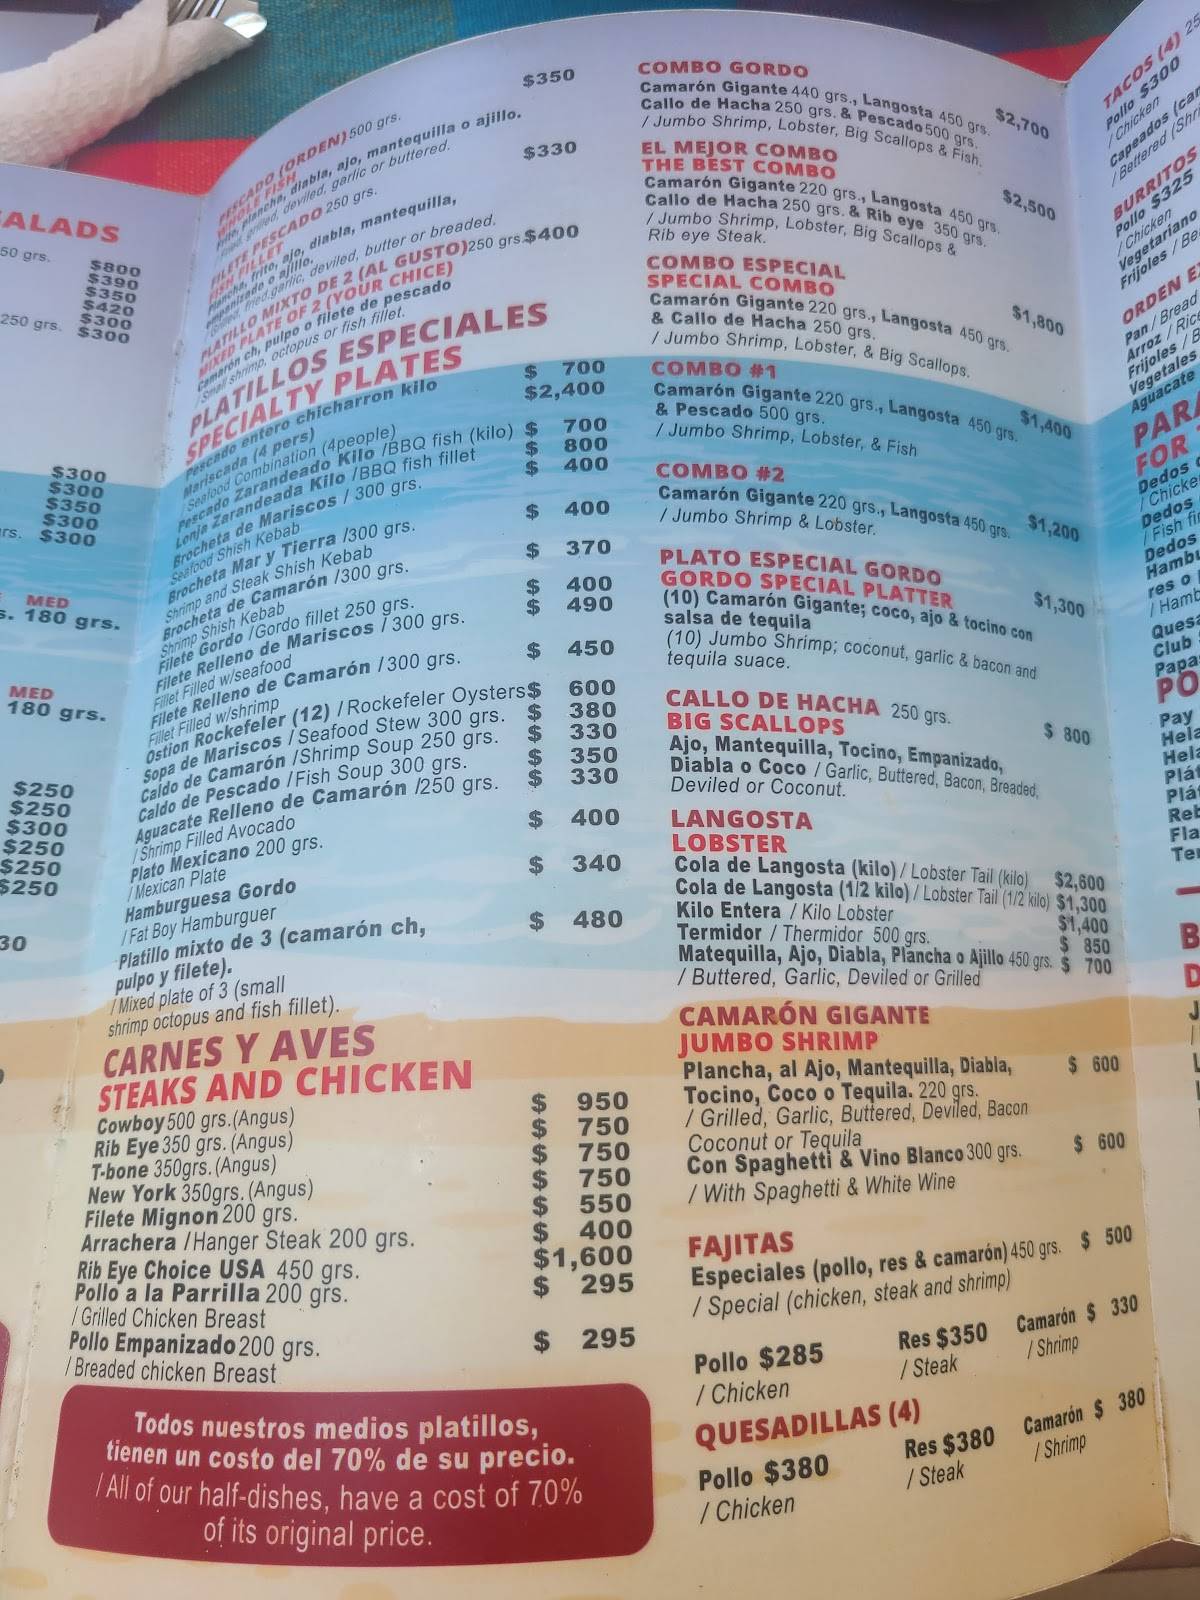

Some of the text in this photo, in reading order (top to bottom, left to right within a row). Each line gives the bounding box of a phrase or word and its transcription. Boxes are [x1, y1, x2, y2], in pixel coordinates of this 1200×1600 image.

[523, 69, 575, 88] $350
[638, 60, 809, 78] COMBO GORDO
[1103, 31, 1181, 109] TACOS (4)
[640, 78, 991, 137] Camarón Gigante 440 grs., Langosta 450 grs.
[1107, 99, 1135, 131] Pollo
[995, 107, 1049, 140] $2,700
[279, 113, 400, 179] (ORDEN) 500 grs.
[291, 110, 521, 195] diabla, ajo, mantequilla o ajillo.
[523, 141, 577, 160] $330
[642, 140, 838, 163] EL MEJOR COMBO
[1113, 146, 1197, 221] BURRITOS
[1002, 188, 1057, 222] $2,500
[253, 207, 323, 255] PESCADO
[326, 195, 348, 214] 250
[353, 188, 377, 205] grs.
[365, 214, 495, 256] butter or breaded.
[524, 225, 579, 244] $400
[1115, 209, 1145, 238] Pollo
[648, 228, 766, 245] Rib eye Steak.
[1119, 210, 1197, 271] Vegetariano
[88, 273, 138, 290] $390
[90, 260, 140, 278] $800
[82, 300, 134, 316] $420
[86, 286, 136, 304] $350
[1122, 275, 1181, 324] ORDEN
[1, 314, 62, 332] 250 grs.
[80, 313, 132, 330] $300
[1011, 304, 1065, 337] $1,800
[1127, 334, 1161, 362] Arroz
[189, 302, 549, 438] PLATILLOS ESPECIALES
[1129, 351, 1197, 395] Vegetales
[185, 345, 463, 466] SPECIALTY PLATES
[296, 380, 437, 424] chicharron kilo
[525, 381, 605, 402] $2,400
[1132, 371, 1195, 414] Aguacate
[1136, 434, 1189, 477] FOR
[52, 466, 106, 483] $300
[178, 498, 229, 534] Pescado
[234, 459, 331, 502] Zarandeado
[338, 448, 375, 467] Kilo
[432, 431, 462, 446] fish
[470, 424, 513, 444] (kilo)
[656, 463, 784, 483] COMBO #2
[1138, 462, 1189, 494] Dedos
[48, 481, 104, 498] $300
[45, 498, 101, 514] $350
[1028, 514, 1080, 543] $1,200
[660, 549, 941, 587] PLATO ESPECIAL GORDO
[26, 595, 69, 609] MED
[1034, 590, 1086, 619] $1,300
[24, 609, 120, 630] 180 grs.
[158, 651, 194, 674] Filete
[199, 631, 243, 657] Gordo
[306, 607, 339, 626] fillet
[345, 600, 375, 618] 250
[382, 598, 414, 616] grs.
[667, 651, 790, 670] tequila suace.
[9, 686, 54, 700] MED
[8, 701, 106, 722] 180 grs.
[666, 690, 951, 726] CALLO DE HACHA 250 grs.
[667, 712, 845, 736] BIG SCALLOPS
[13, 781, 74, 799] $250
[10, 800, 71, 817] $250
[671, 810, 812, 830] LANGOSTA
[672, 834, 787, 854] LOBSTER
[131, 835, 323, 883] Plato Mexicano 200 grs.
[1054, 870, 1105, 892] $2,600
[125, 879, 297, 923] Hamburguesa Gordo
[679, 1000, 930, 1026] CAMARÓN GIGANTE
[103, 1024, 375, 1078] CARNES Y AVES
[678, 1030, 878, 1058] JUMBO SHRIMP
[98, 1060, 472, 1112] STEAKS AND CHICKEN
[684, 1082, 978, 1106] Tocino, Coco o Tequila. 220 grs.
[81, 1231, 176, 1252] Arrachera
[266, 1228, 322, 1250] Steak
[329, 1228, 368, 1249] 200
[375, 1229, 415, 1252] grs.
[689, 1231, 793, 1262] FAJITAS
[533, 1246, 634, 1272] $1,600
[899, 1322, 987, 1351] Res $350
[695, 1342, 823, 1374] Pollo $285
[134, 1411, 538, 1443] Todos nuestros medios platillos,
[695, 1399, 920, 1450] QUESADILLAS (4)
[204, 1519, 433, 1550] of its original price.
